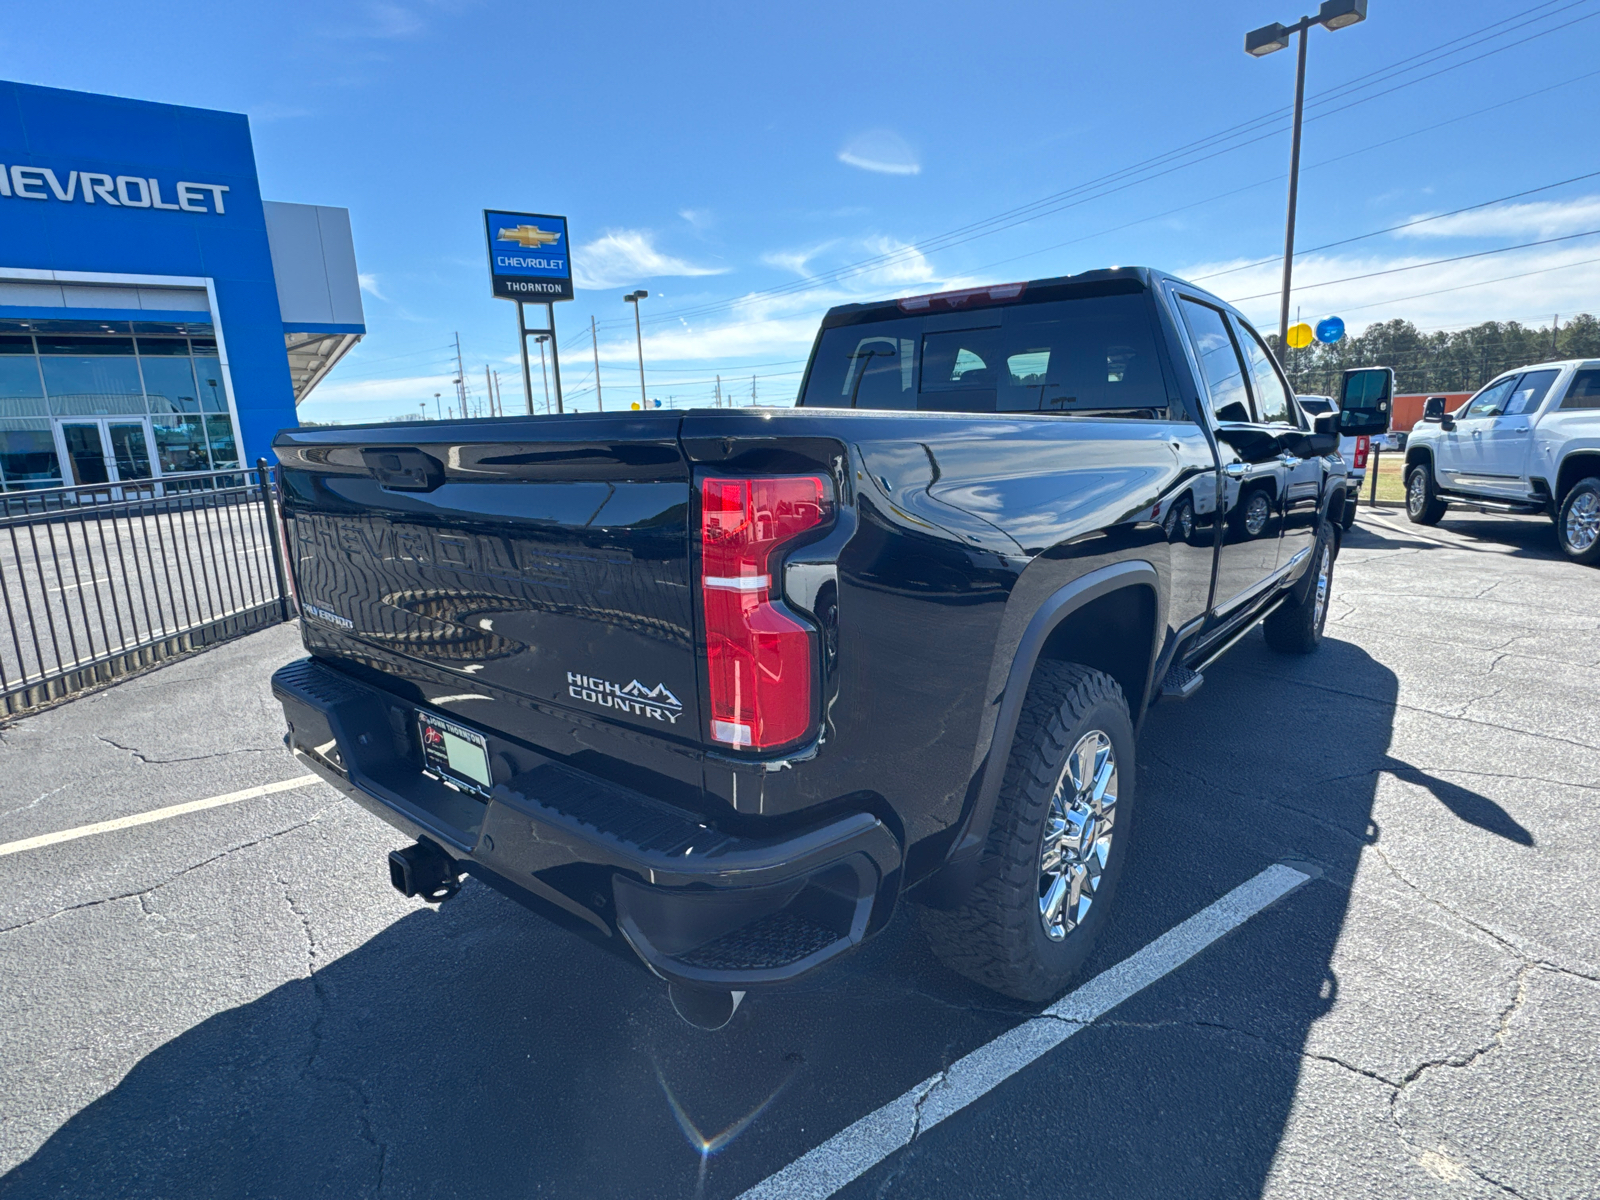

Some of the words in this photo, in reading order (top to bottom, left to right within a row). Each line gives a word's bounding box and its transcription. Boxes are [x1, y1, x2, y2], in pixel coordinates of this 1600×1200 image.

[497, 256, 564, 269] CHEVROLET
[506, 282, 562, 293] THORNTON
[567, 672, 620, 695] HIGH
[569, 685, 682, 723] COUNTRY
[429, 717, 446, 730] JOHN
[446, 723, 481, 745] THORNTON
